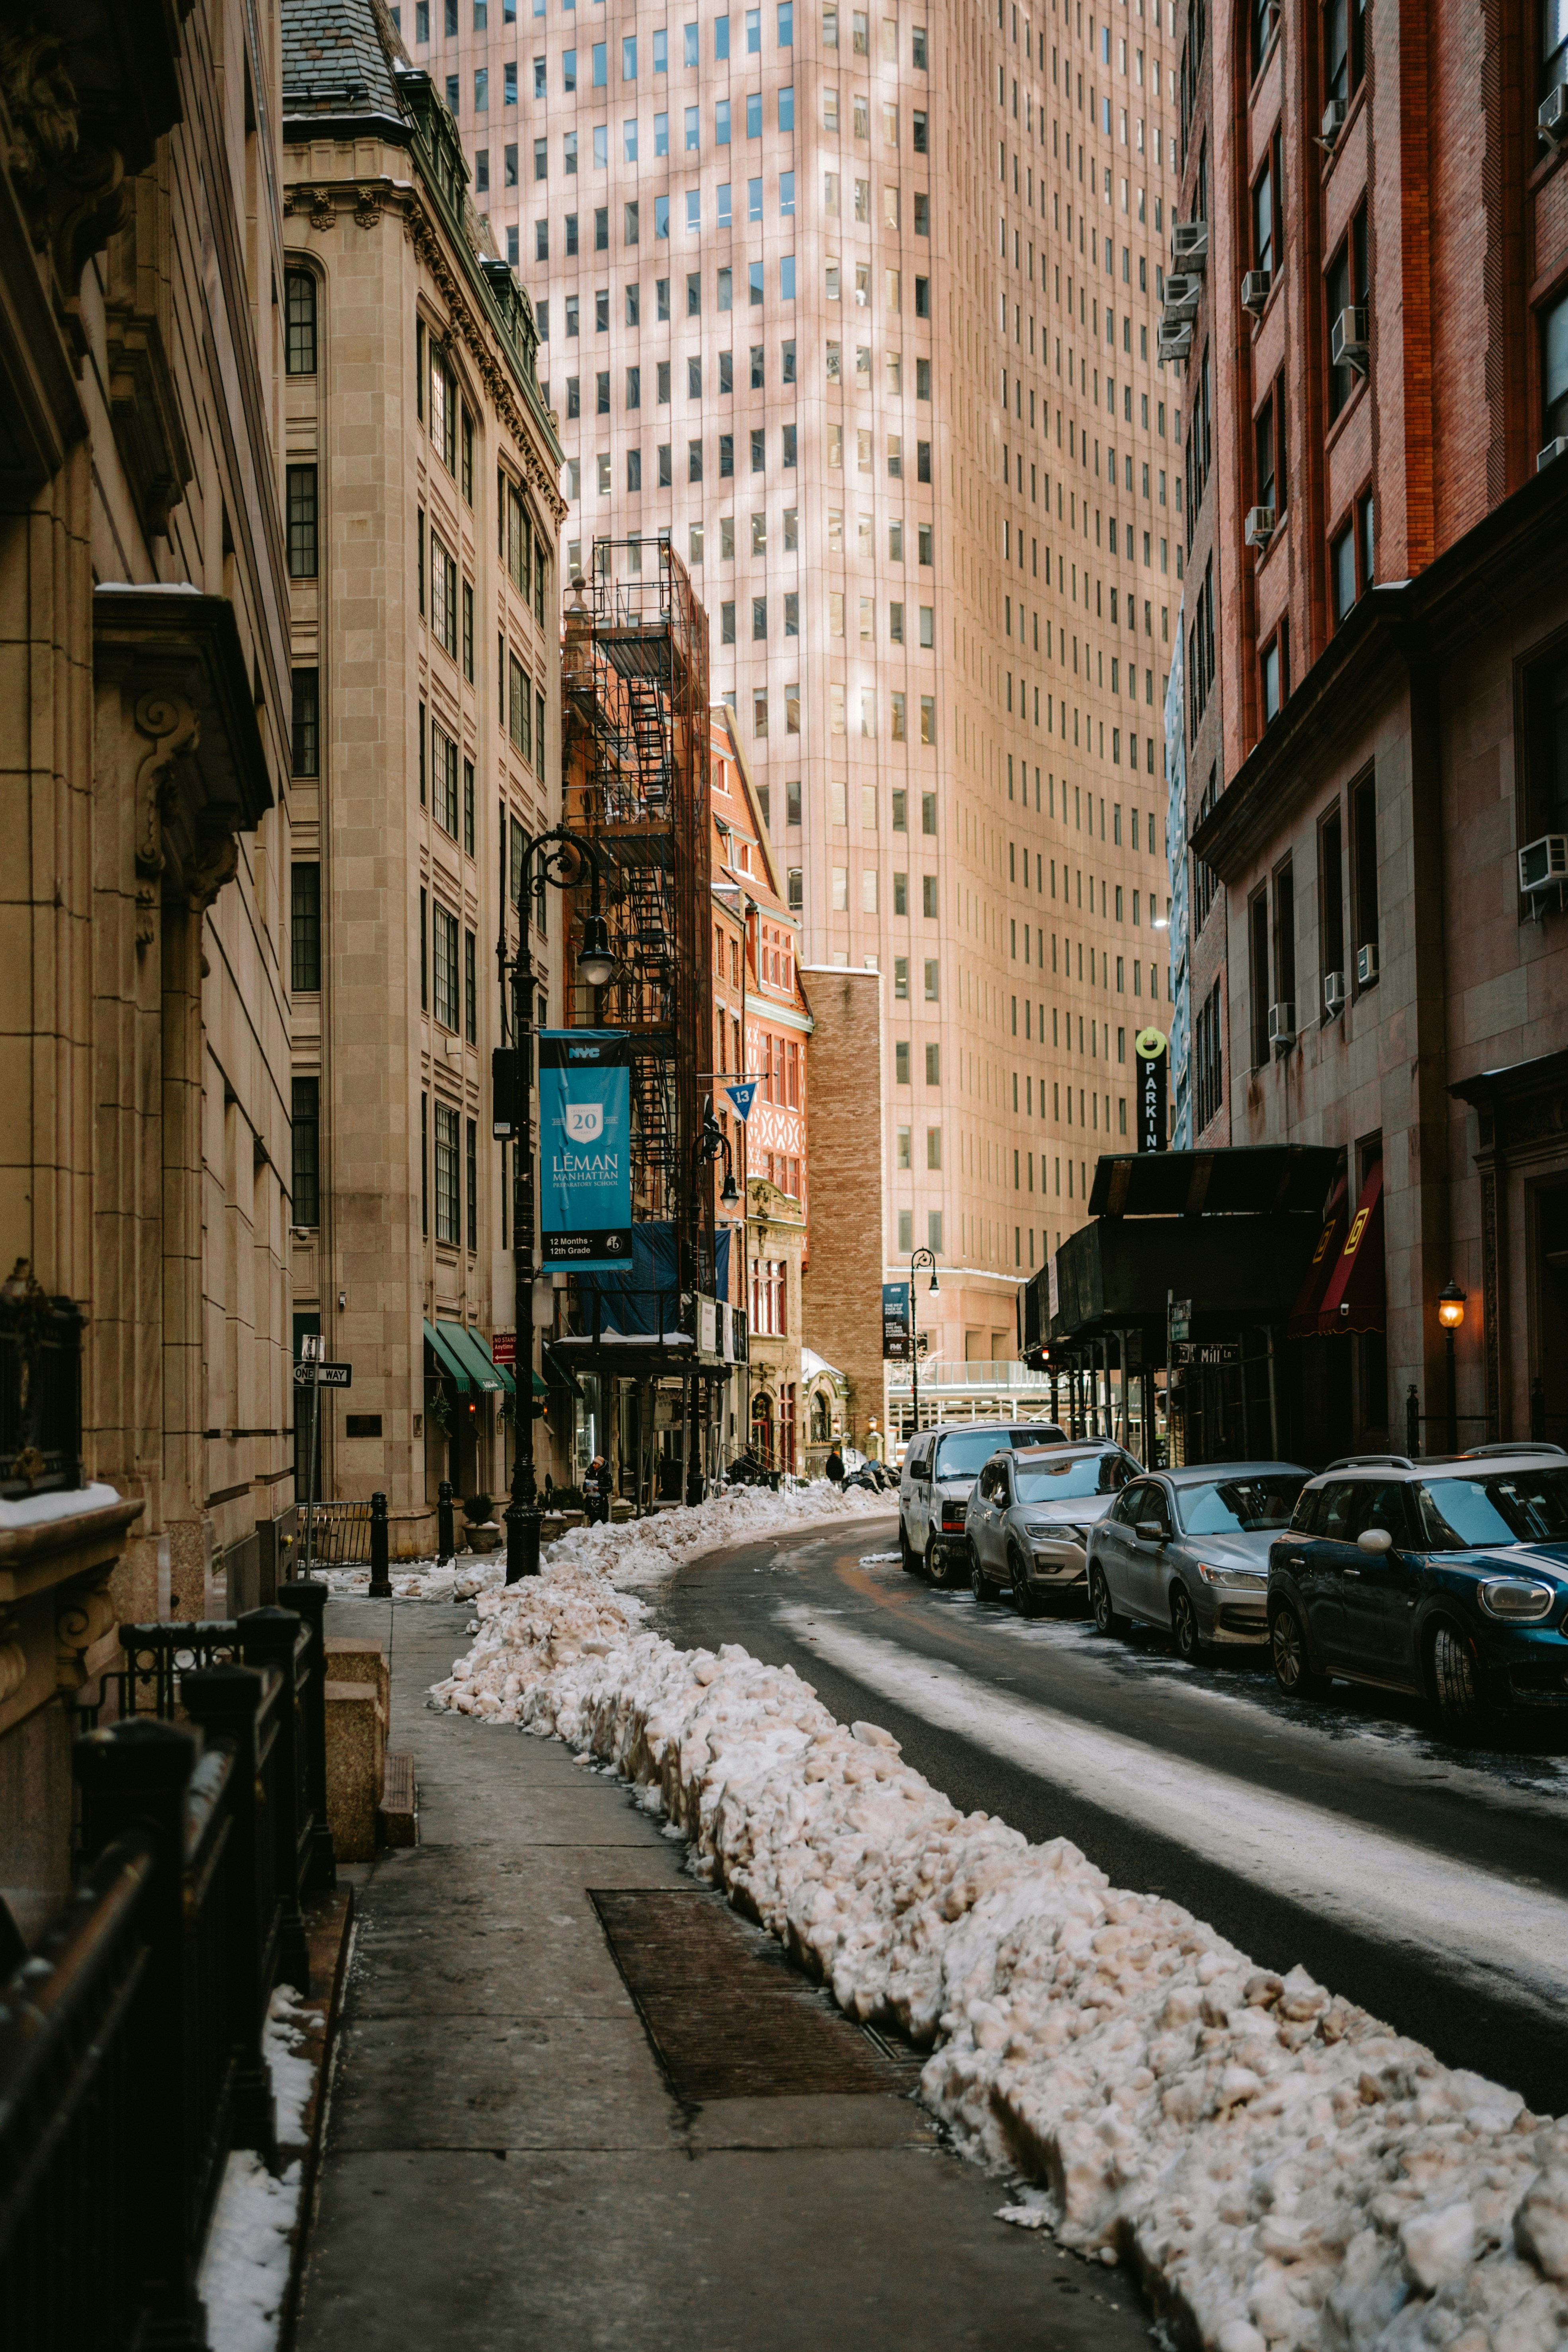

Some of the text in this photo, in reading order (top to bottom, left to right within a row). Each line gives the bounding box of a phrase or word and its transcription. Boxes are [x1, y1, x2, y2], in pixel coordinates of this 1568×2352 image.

[569, 1048, 600, 1058] NYC
[736, 1090, 750, 1103] 13
[1145, 1062, 1157, 1153] PARKIN
[573, 1113, 597, 1130] 20
[553, 1152, 618, 1171] LÉMAN
[553, 1171, 618, 1181] MANHATTAN
[1201, 1349, 1220, 1362] Mill
[296, 1368, 344, 1380] ONE WAY
